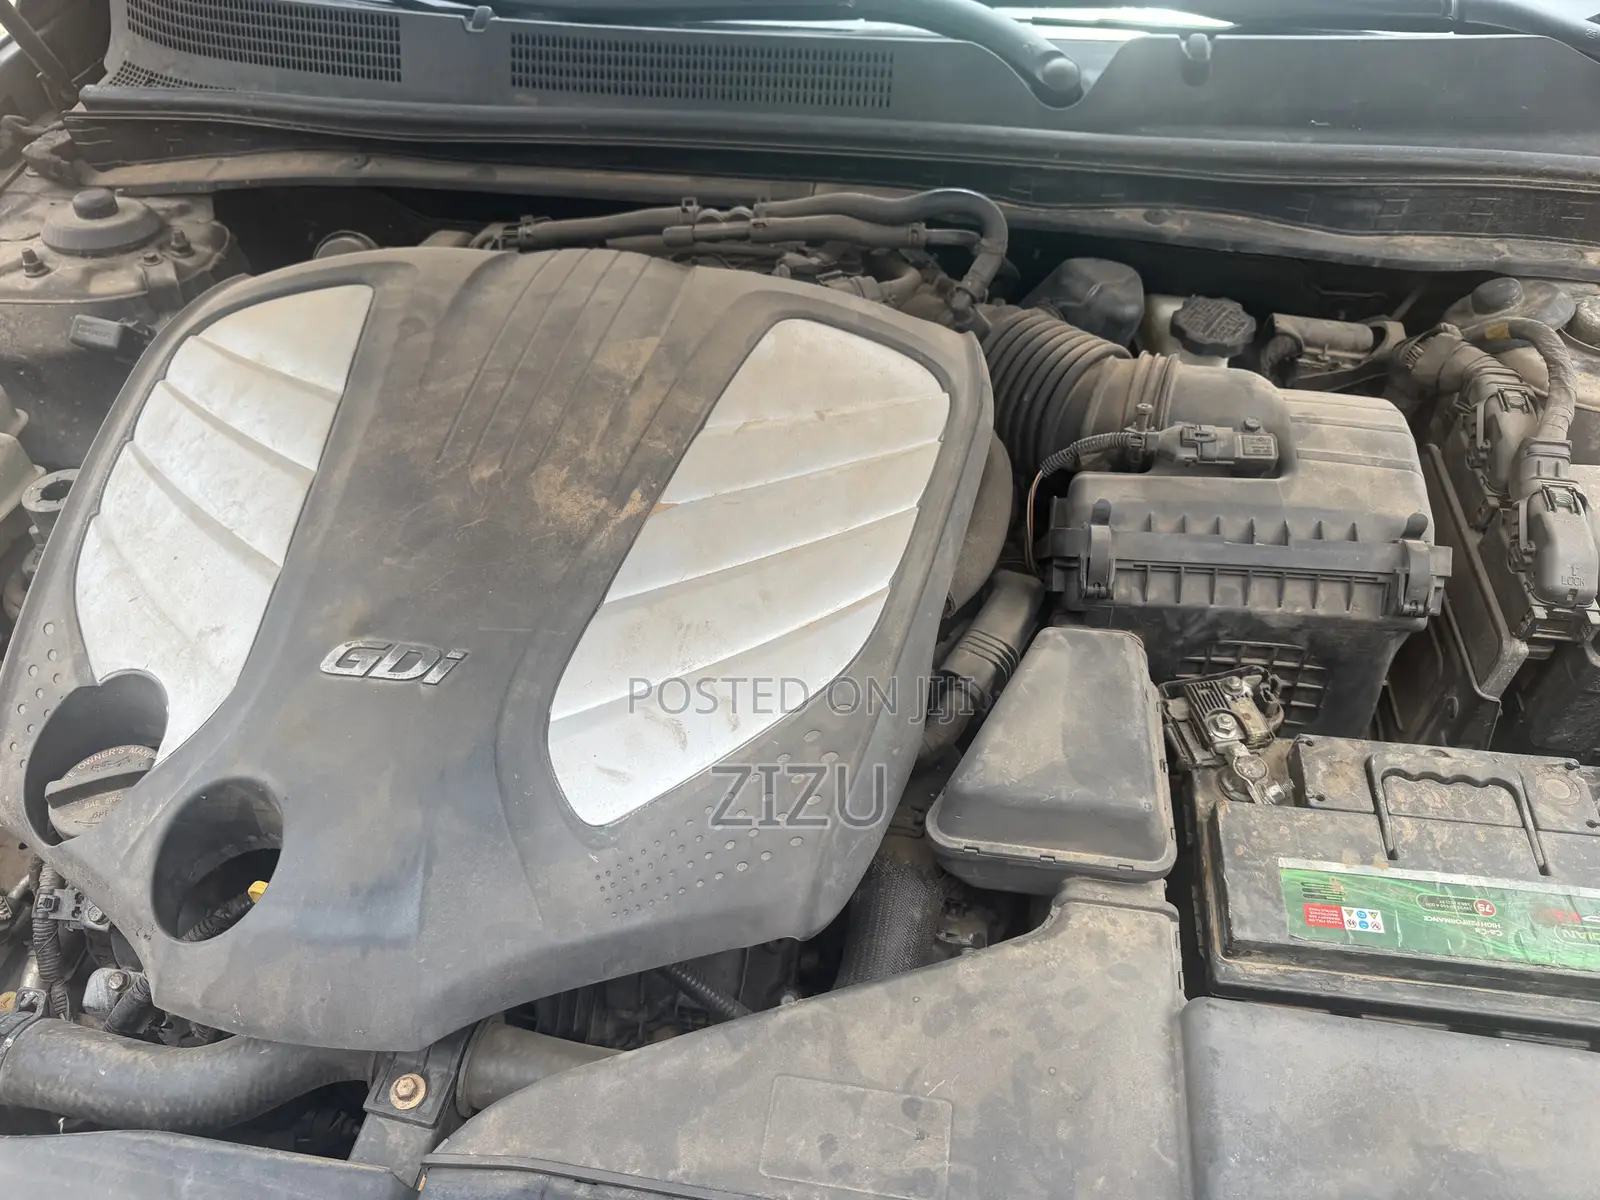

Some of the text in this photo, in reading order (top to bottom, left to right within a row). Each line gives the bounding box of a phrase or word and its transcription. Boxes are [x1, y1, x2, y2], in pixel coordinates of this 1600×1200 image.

[1561, 575, 1585, 587] LOCK
[320, 639, 468, 685] GDi
[77, 747, 125, 770] OWNER'S
[128, 746, 158, 761] MANU
[84, 799, 101, 810] SAE
[91, 808, 110, 820] OPE
[1477, 903, 1493, 913] 75
[1423, 915, 1501, 929] HIGH PERFORMANCE
